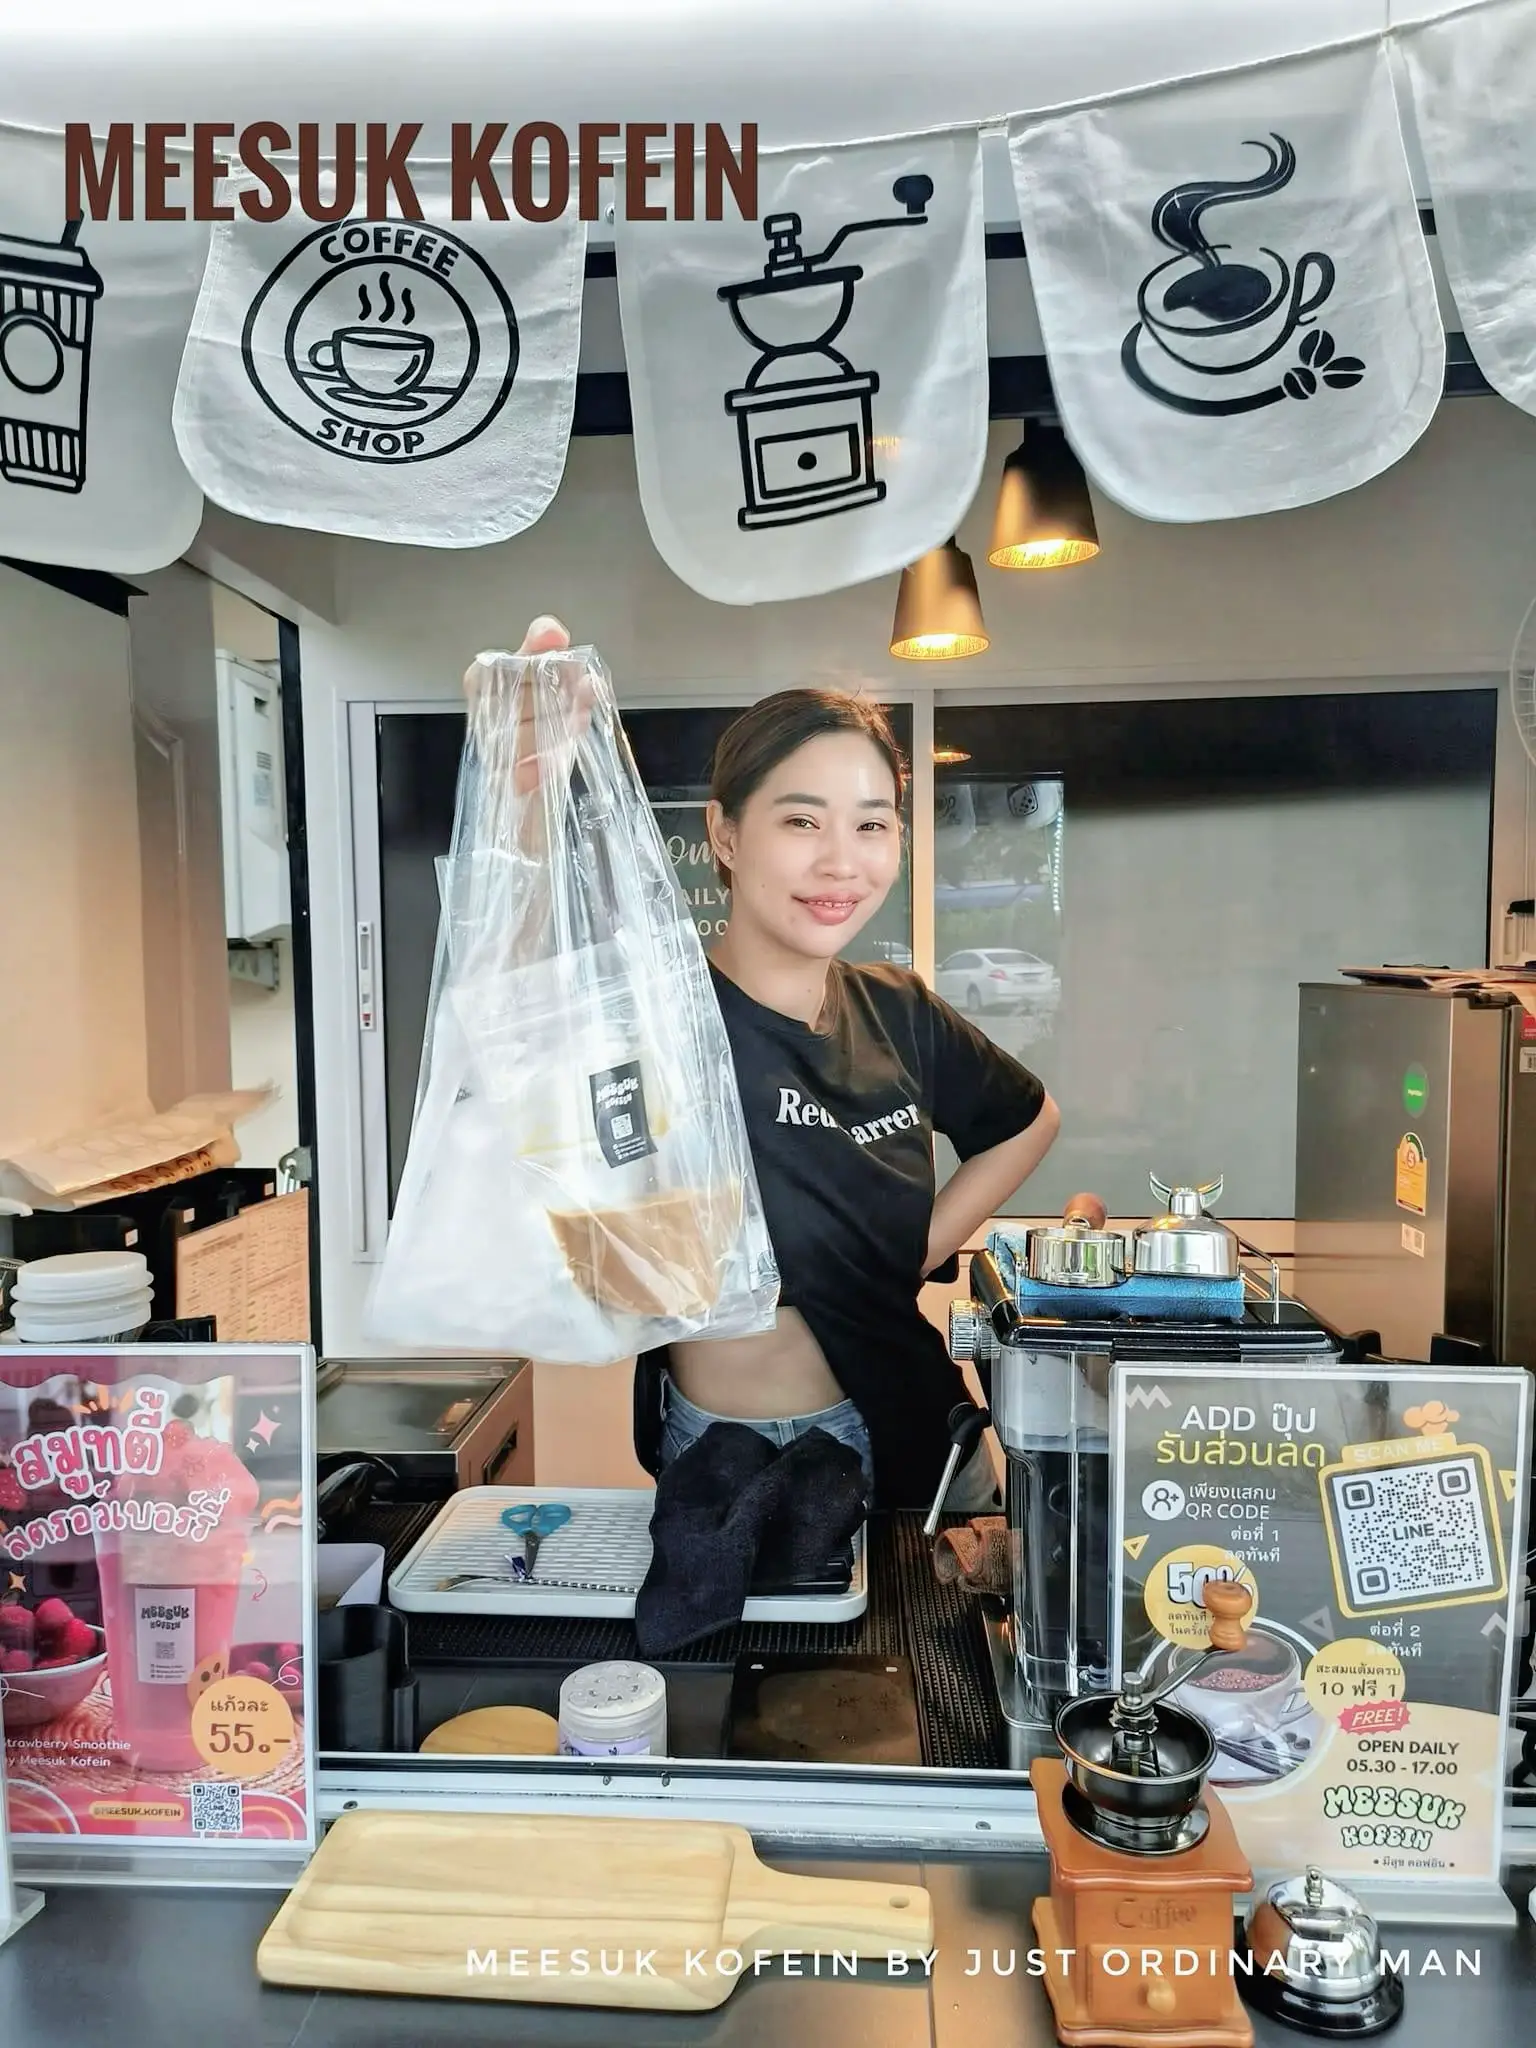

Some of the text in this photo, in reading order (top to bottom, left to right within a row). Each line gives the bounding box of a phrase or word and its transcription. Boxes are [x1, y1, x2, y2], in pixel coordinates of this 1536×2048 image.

[319, 226, 459, 278] COFFEE
[316, 418, 425, 455] SHOP
[679, 887, 730, 905] AILY
[1181, 1405, 1256, 1431] ADD
[1156, 1430, 1326, 1468] รับส่วนลด
[1354, 1438, 1444, 1463] SCAN ME
[1189, 1482, 1276, 1500] เพียงแสกน
[1185, 1503, 1270, 1520] QR CODE
[1230, 1521, 1279, 1542] ต่อที่ 1
[1392, 1523, 1435, 1541] LINE
[1369, 1617, 1421, 1637] ต่อที่ 2
[1319, 1678, 1396, 1697] 10 ฟรี 1
[210, 1693, 269, 1712] แก้วละ
[1352, 1706, 1404, 1727] FREE!
[7, 1738, 131, 1750] trawberry Smoothie
[1357, 1739, 1460, 1755] OPEN DAILY
[20, 1756, 66, 1766] Meesuk
[70, 1756, 111, 1767] Kofein
[1346, 1759, 1396, 1773] 05.30
[1411, 1761, 1458, 1775] 17.00
[1324, 1785, 1466, 1830] MEESUK
[1341, 1823, 1433, 1851] KOFEIN
